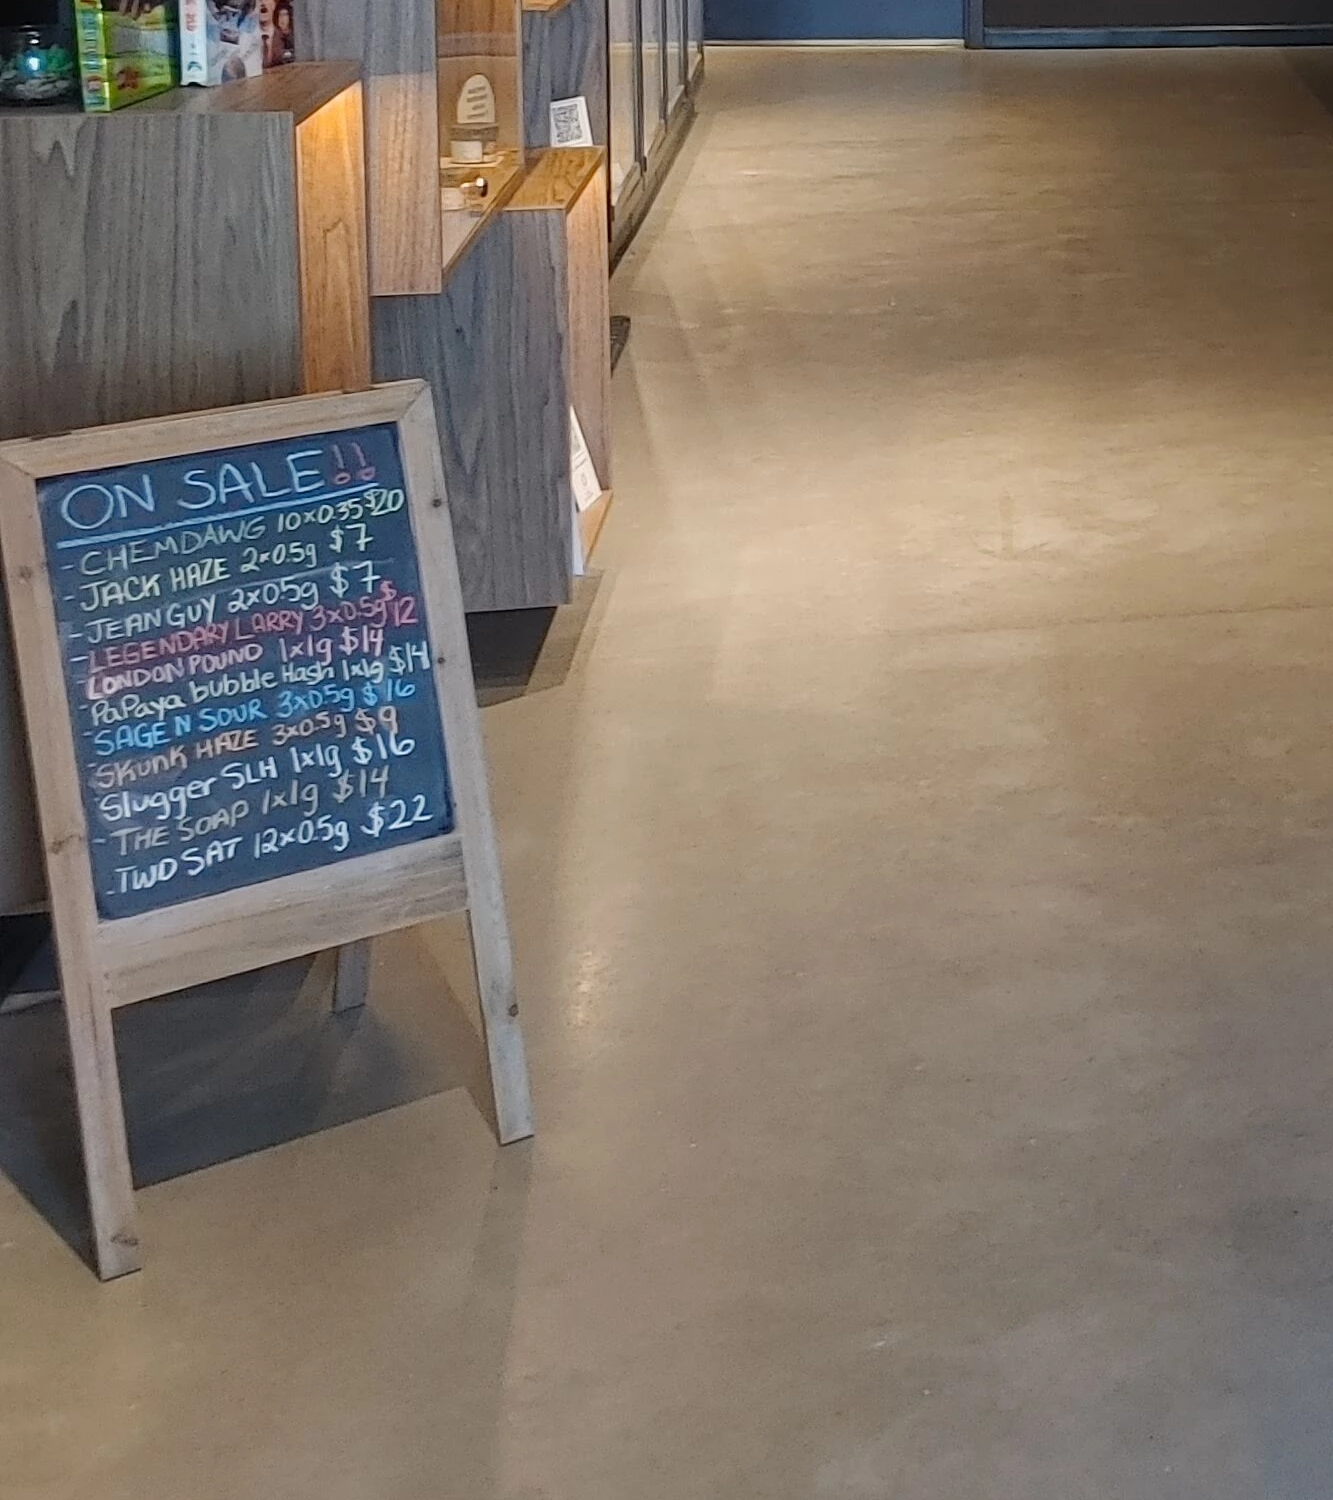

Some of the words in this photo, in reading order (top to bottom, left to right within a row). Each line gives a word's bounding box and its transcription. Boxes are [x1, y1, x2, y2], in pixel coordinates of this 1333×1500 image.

[61, 474, 155, 530] ON
[80, 516, 267, 576] CHEMDAWG
[365, 489, 405, 517] $20
[79, 573, 161, 612] JACK
[169, 558, 231, 592] HAZE
[85, 608, 162, 644] JEAN
[166, 594, 216, 628] GUY
[89, 621, 230, 674] LEGENDARY
[235, 609, 304, 641] LARRY
[380, 580, 418, 627] $12
[87, 657, 184, 700] LONDON
[189, 643, 263, 675] POUND
[339, 626, 384, 657] $14
[189, 663, 278, 704] bubble
[281, 660, 335, 686] Hash
[389, 640, 431, 675] $14
[94, 722, 171, 756] SAGE
[175, 714, 191, 736] N
[199, 698, 268, 731] SOUR
[196, 729, 259, 760] HAZE
[100, 776, 218, 821] Slugger
[221, 756, 279, 790] SLH
[353, 732, 415, 765] $16
[110, 826, 170, 856] THE
[177, 800, 250, 842] SOAP
[333, 764, 390, 804] $14
[180, 836, 243, 876] SAT
[360, 794, 433, 838] $22
